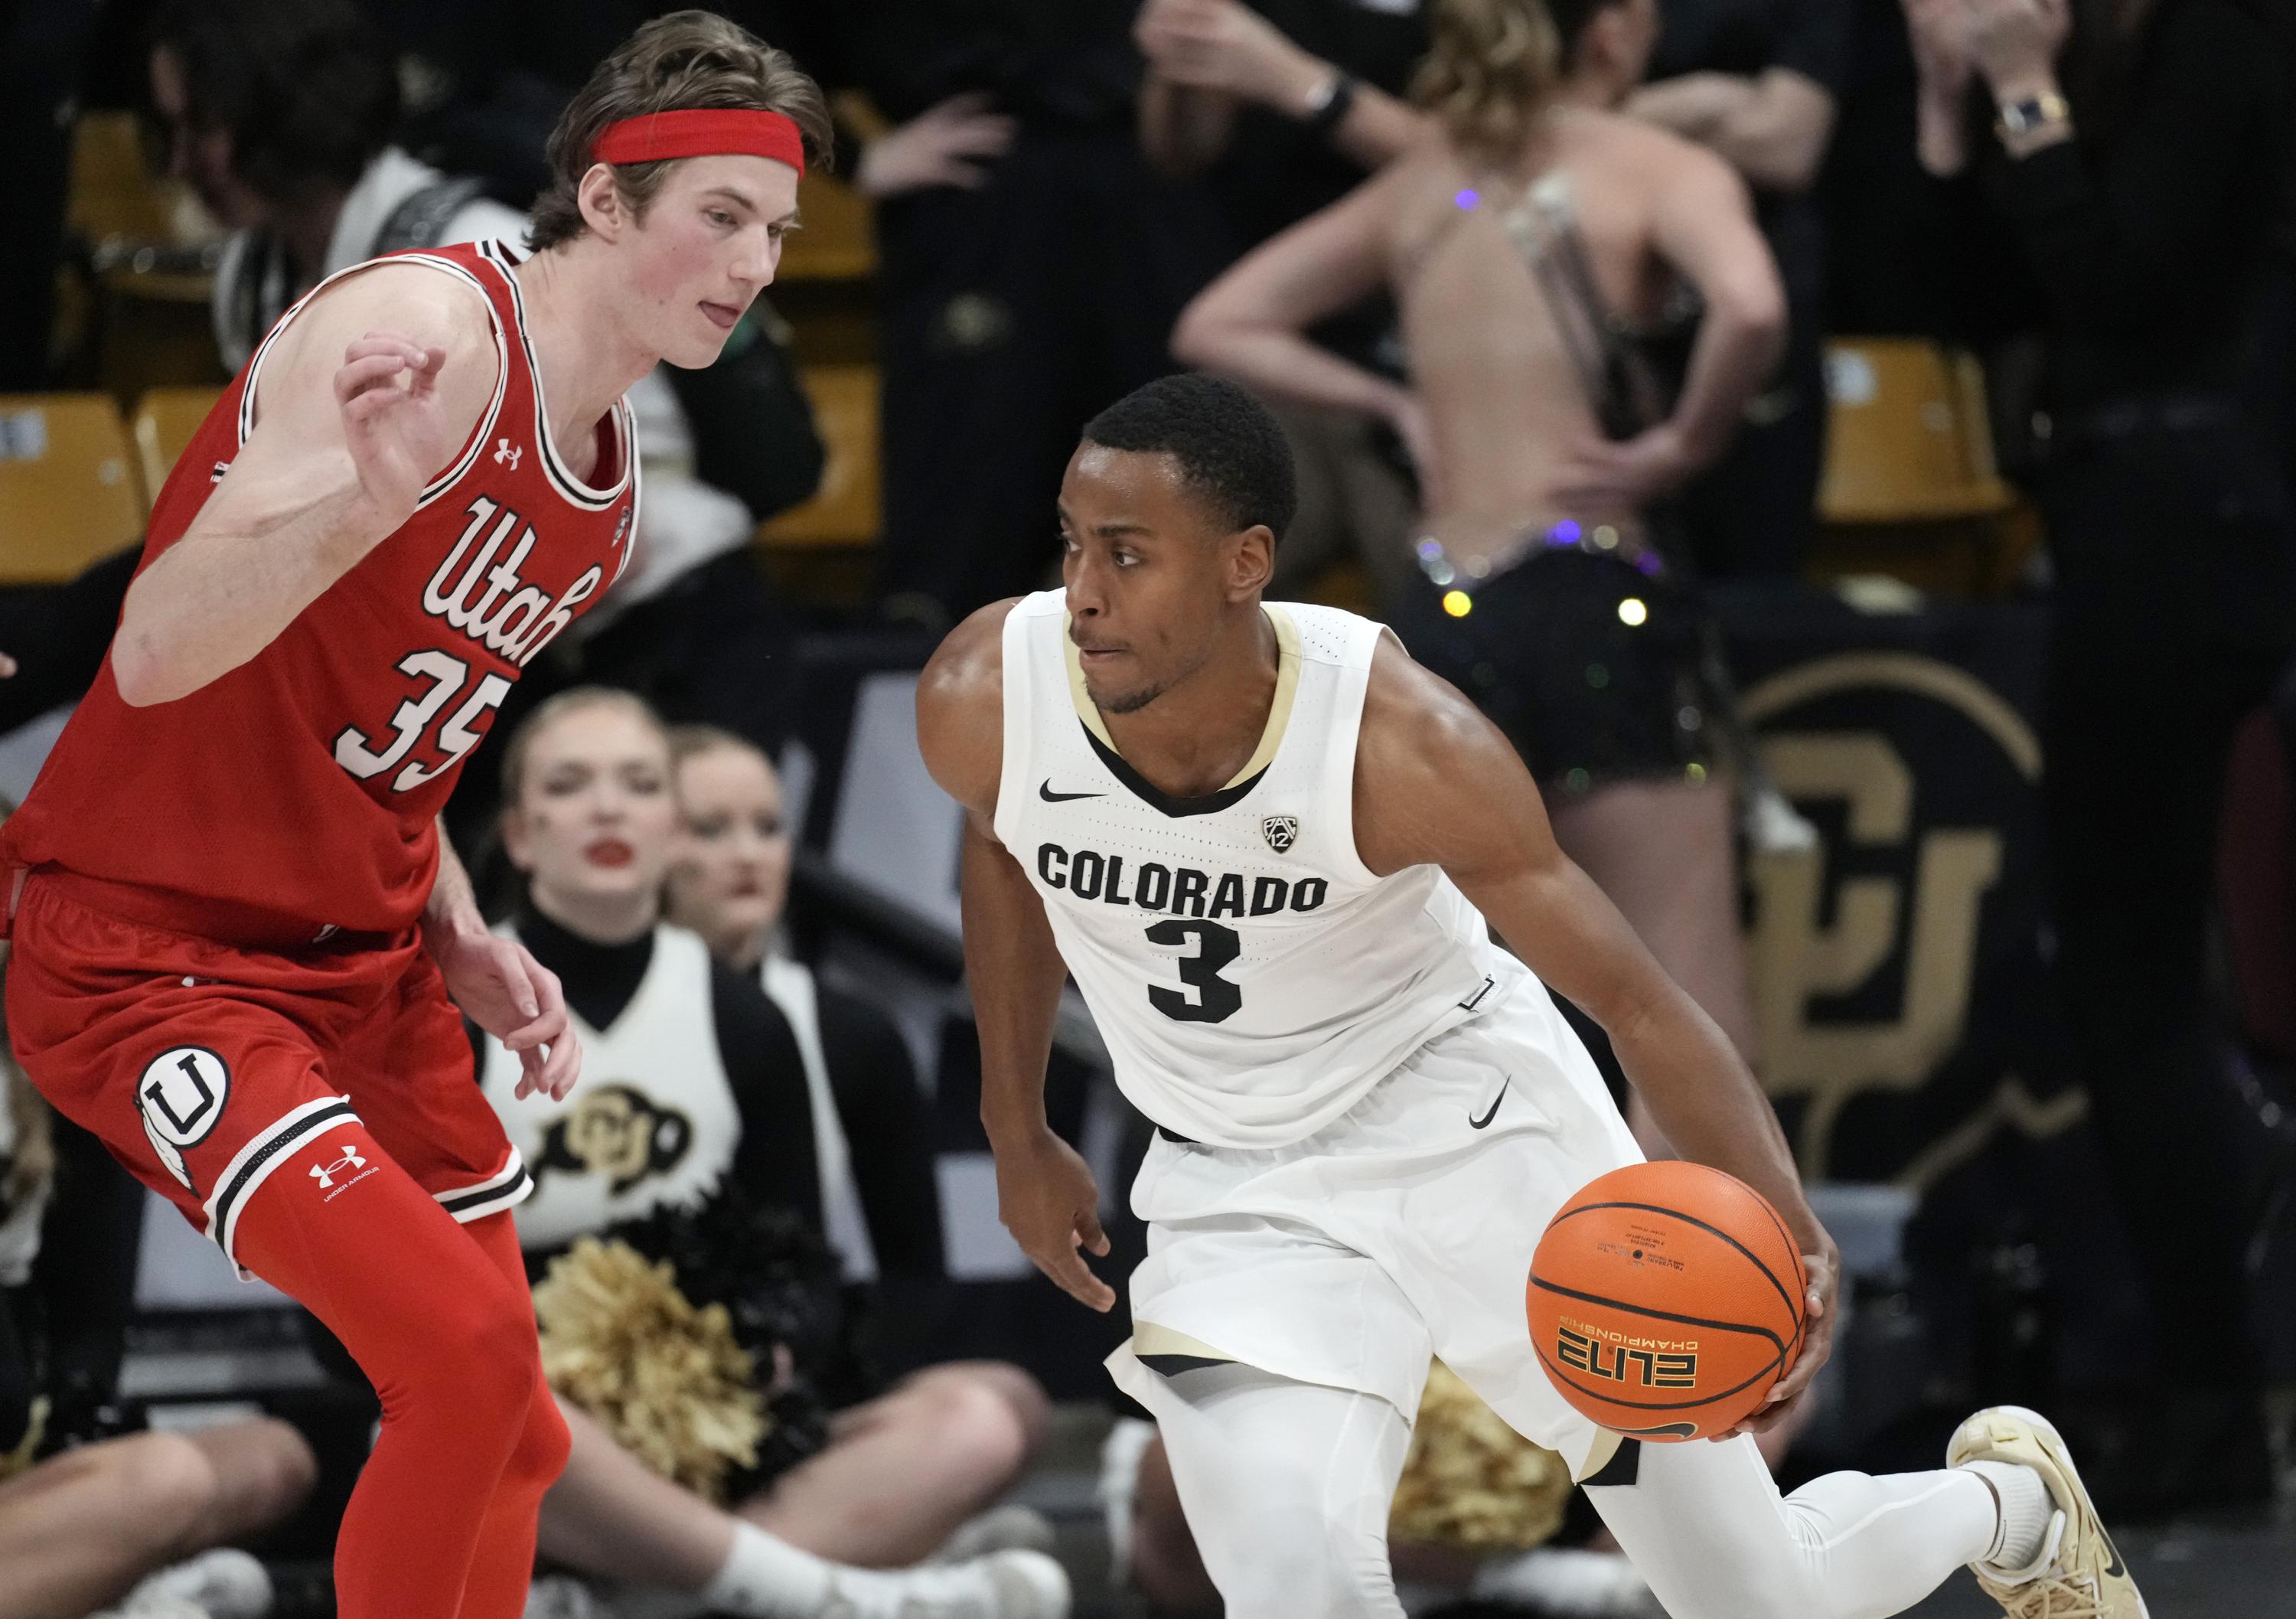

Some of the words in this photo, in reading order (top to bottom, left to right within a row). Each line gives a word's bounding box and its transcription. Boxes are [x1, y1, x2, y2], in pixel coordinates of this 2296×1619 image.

[422, 493, 603, 669] Utah
[334, 648, 514, 793] 35
[1263, 817, 1296, 841] PAC
[1271, 832, 1290, 847] 12
[1037, 842, 1329, 919] COLORADO
[1144, 919, 1243, 1024] 3
[143, 1053, 215, 1135] U
[323, 1183, 349, 1203] UNDER
[348, 1166, 380, 1187] ARMOUR
[1557, 1325, 1698, 1389] ELITE
[1559, 1314, 1698, 1351] CHAMPIONSHIP
